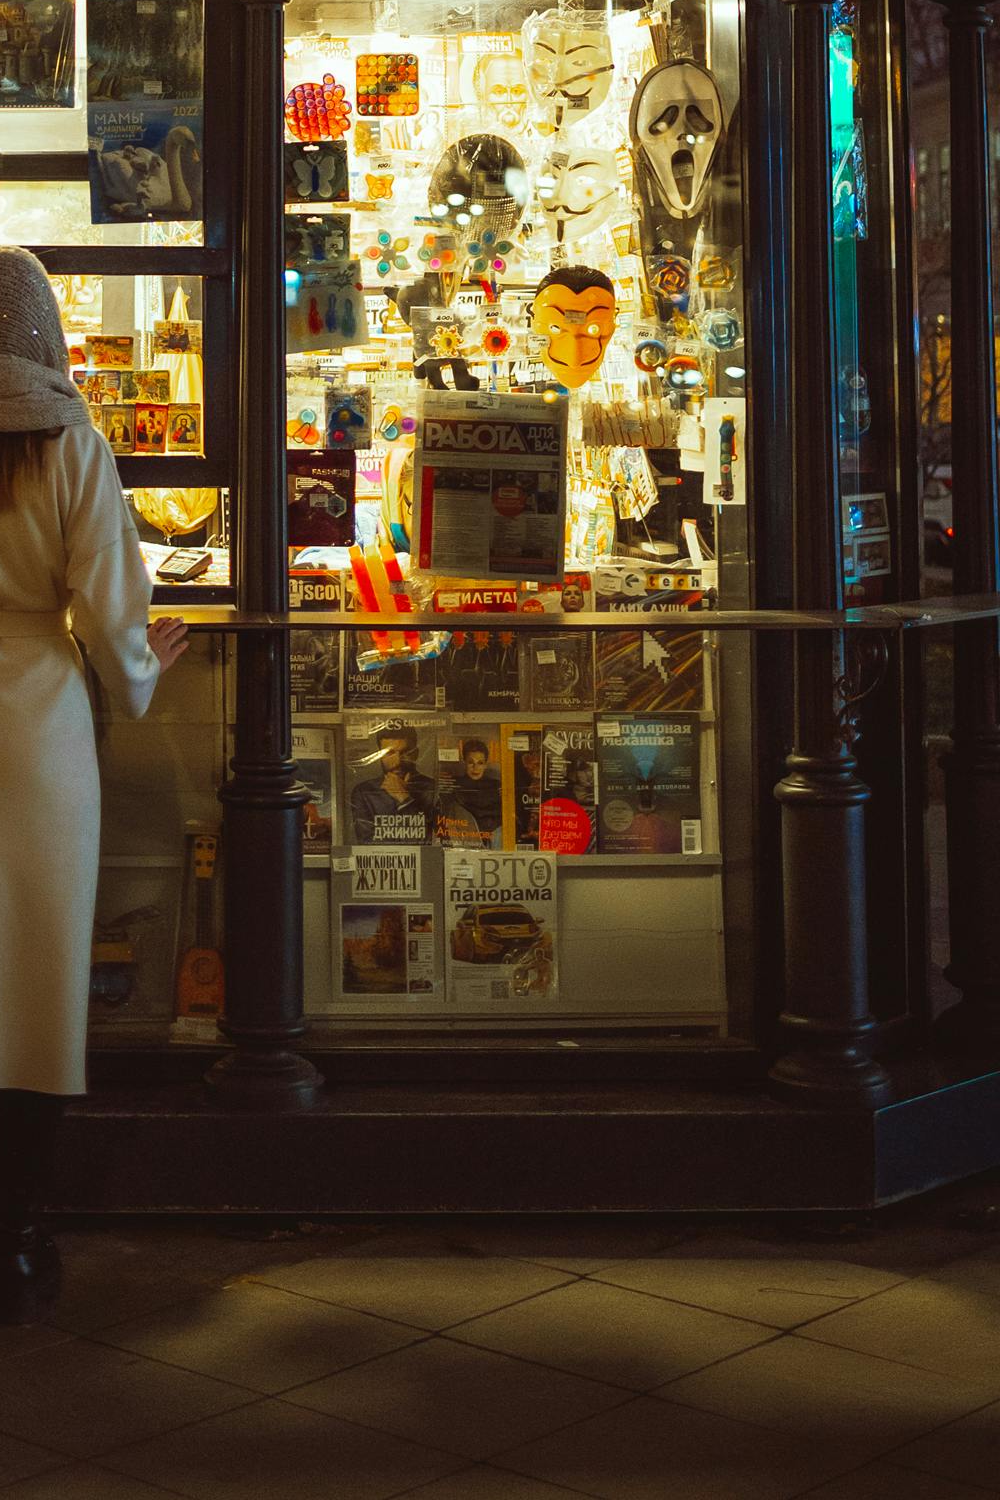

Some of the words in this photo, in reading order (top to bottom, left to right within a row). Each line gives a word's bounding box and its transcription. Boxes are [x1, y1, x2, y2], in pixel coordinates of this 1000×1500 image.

[94, 112, 144, 125] МАМЫ
[173, 106, 200, 117] 2022
[425, 422, 526, 452] РАБОТА
[527, 426, 554, 439] ДЛЯ
[535, 441, 559, 452] ВАС
[348, 675, 380, 683] НАШИ
[356, 684, 395, 693] ГОРОДЕ
[621, 724, 692, 736] пулярная
[374, 812, 426, 827] ГЕОРГИЙ
[373, 827, 426, 841] ДЖИКИЯ
[355, 852, 417, 869] МОСКОВСКИЙ
[356, 869, 417, 891] ЖУРНАЛ
[450, 858, 552, 888] АВТО
[450, 888, 552, 903] панорама
